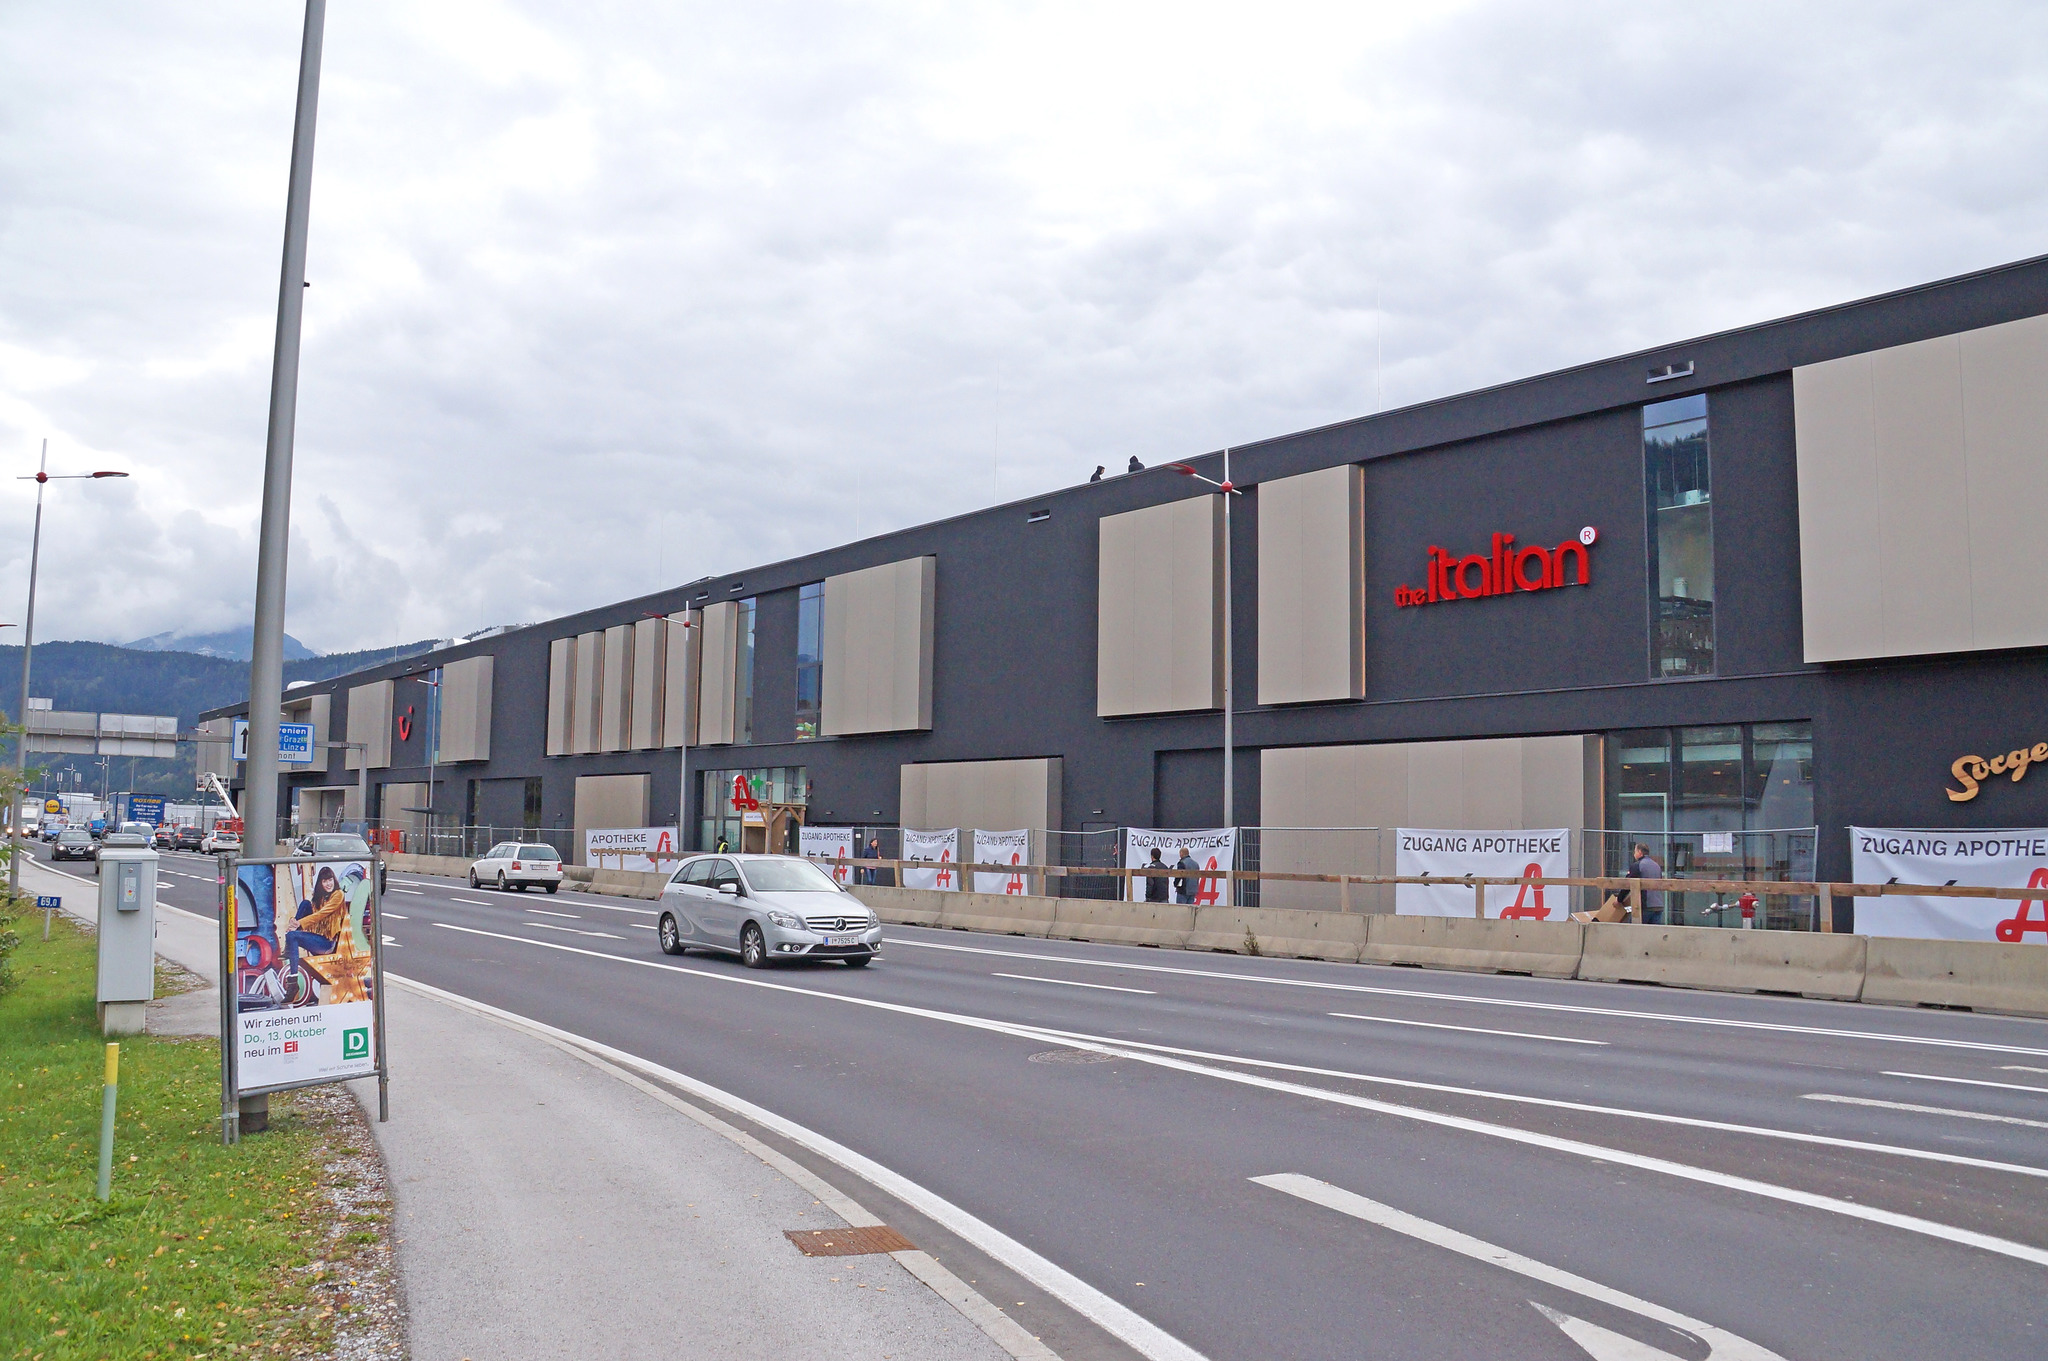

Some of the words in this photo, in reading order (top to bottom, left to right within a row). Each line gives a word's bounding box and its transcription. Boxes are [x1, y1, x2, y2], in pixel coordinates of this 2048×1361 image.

[1395, 583, 1427, 607] the
[1427, 532, 1590, 603] italian
[284, 735, 301, 743] Graz
[591, 833, 647, 844] APOTHEKE
[801, 832, 822, 841] ZUGANG
[823, 833, 851, 841] APOTHEKE
[906, 833, 927, 844] ZUGANG
[928, 833, 955, 844] APOTHEKE
[1131, 835, 1172, 849] ZUGANG
[1174, 834, 1231, 849] APOTHEKE
[1402, 836, 1468, 853] ZUGANG
[1472, 837, 1561, 853] APOTHEKE
[1860, 837, 1948, 856] ZUGANG
[1954, 839, 2046, 857] APOTHE
[243, 1019, 262, 1029] Wir
[265, 1016, 300, 1028] ziehen
[302, 1012, 322, 1023] um!
[244, 1033, 266, 1044] Do.,
[268, 1031, 282, 1041] 13.
[284, 1026, 327, 1040] Oktober
[348, 1032, 364, 1051] D
[244, 1048, 265, 1058] neu
[267, 1045, 281, 1055] im
[284, 1040, 298, 1053] Eli
